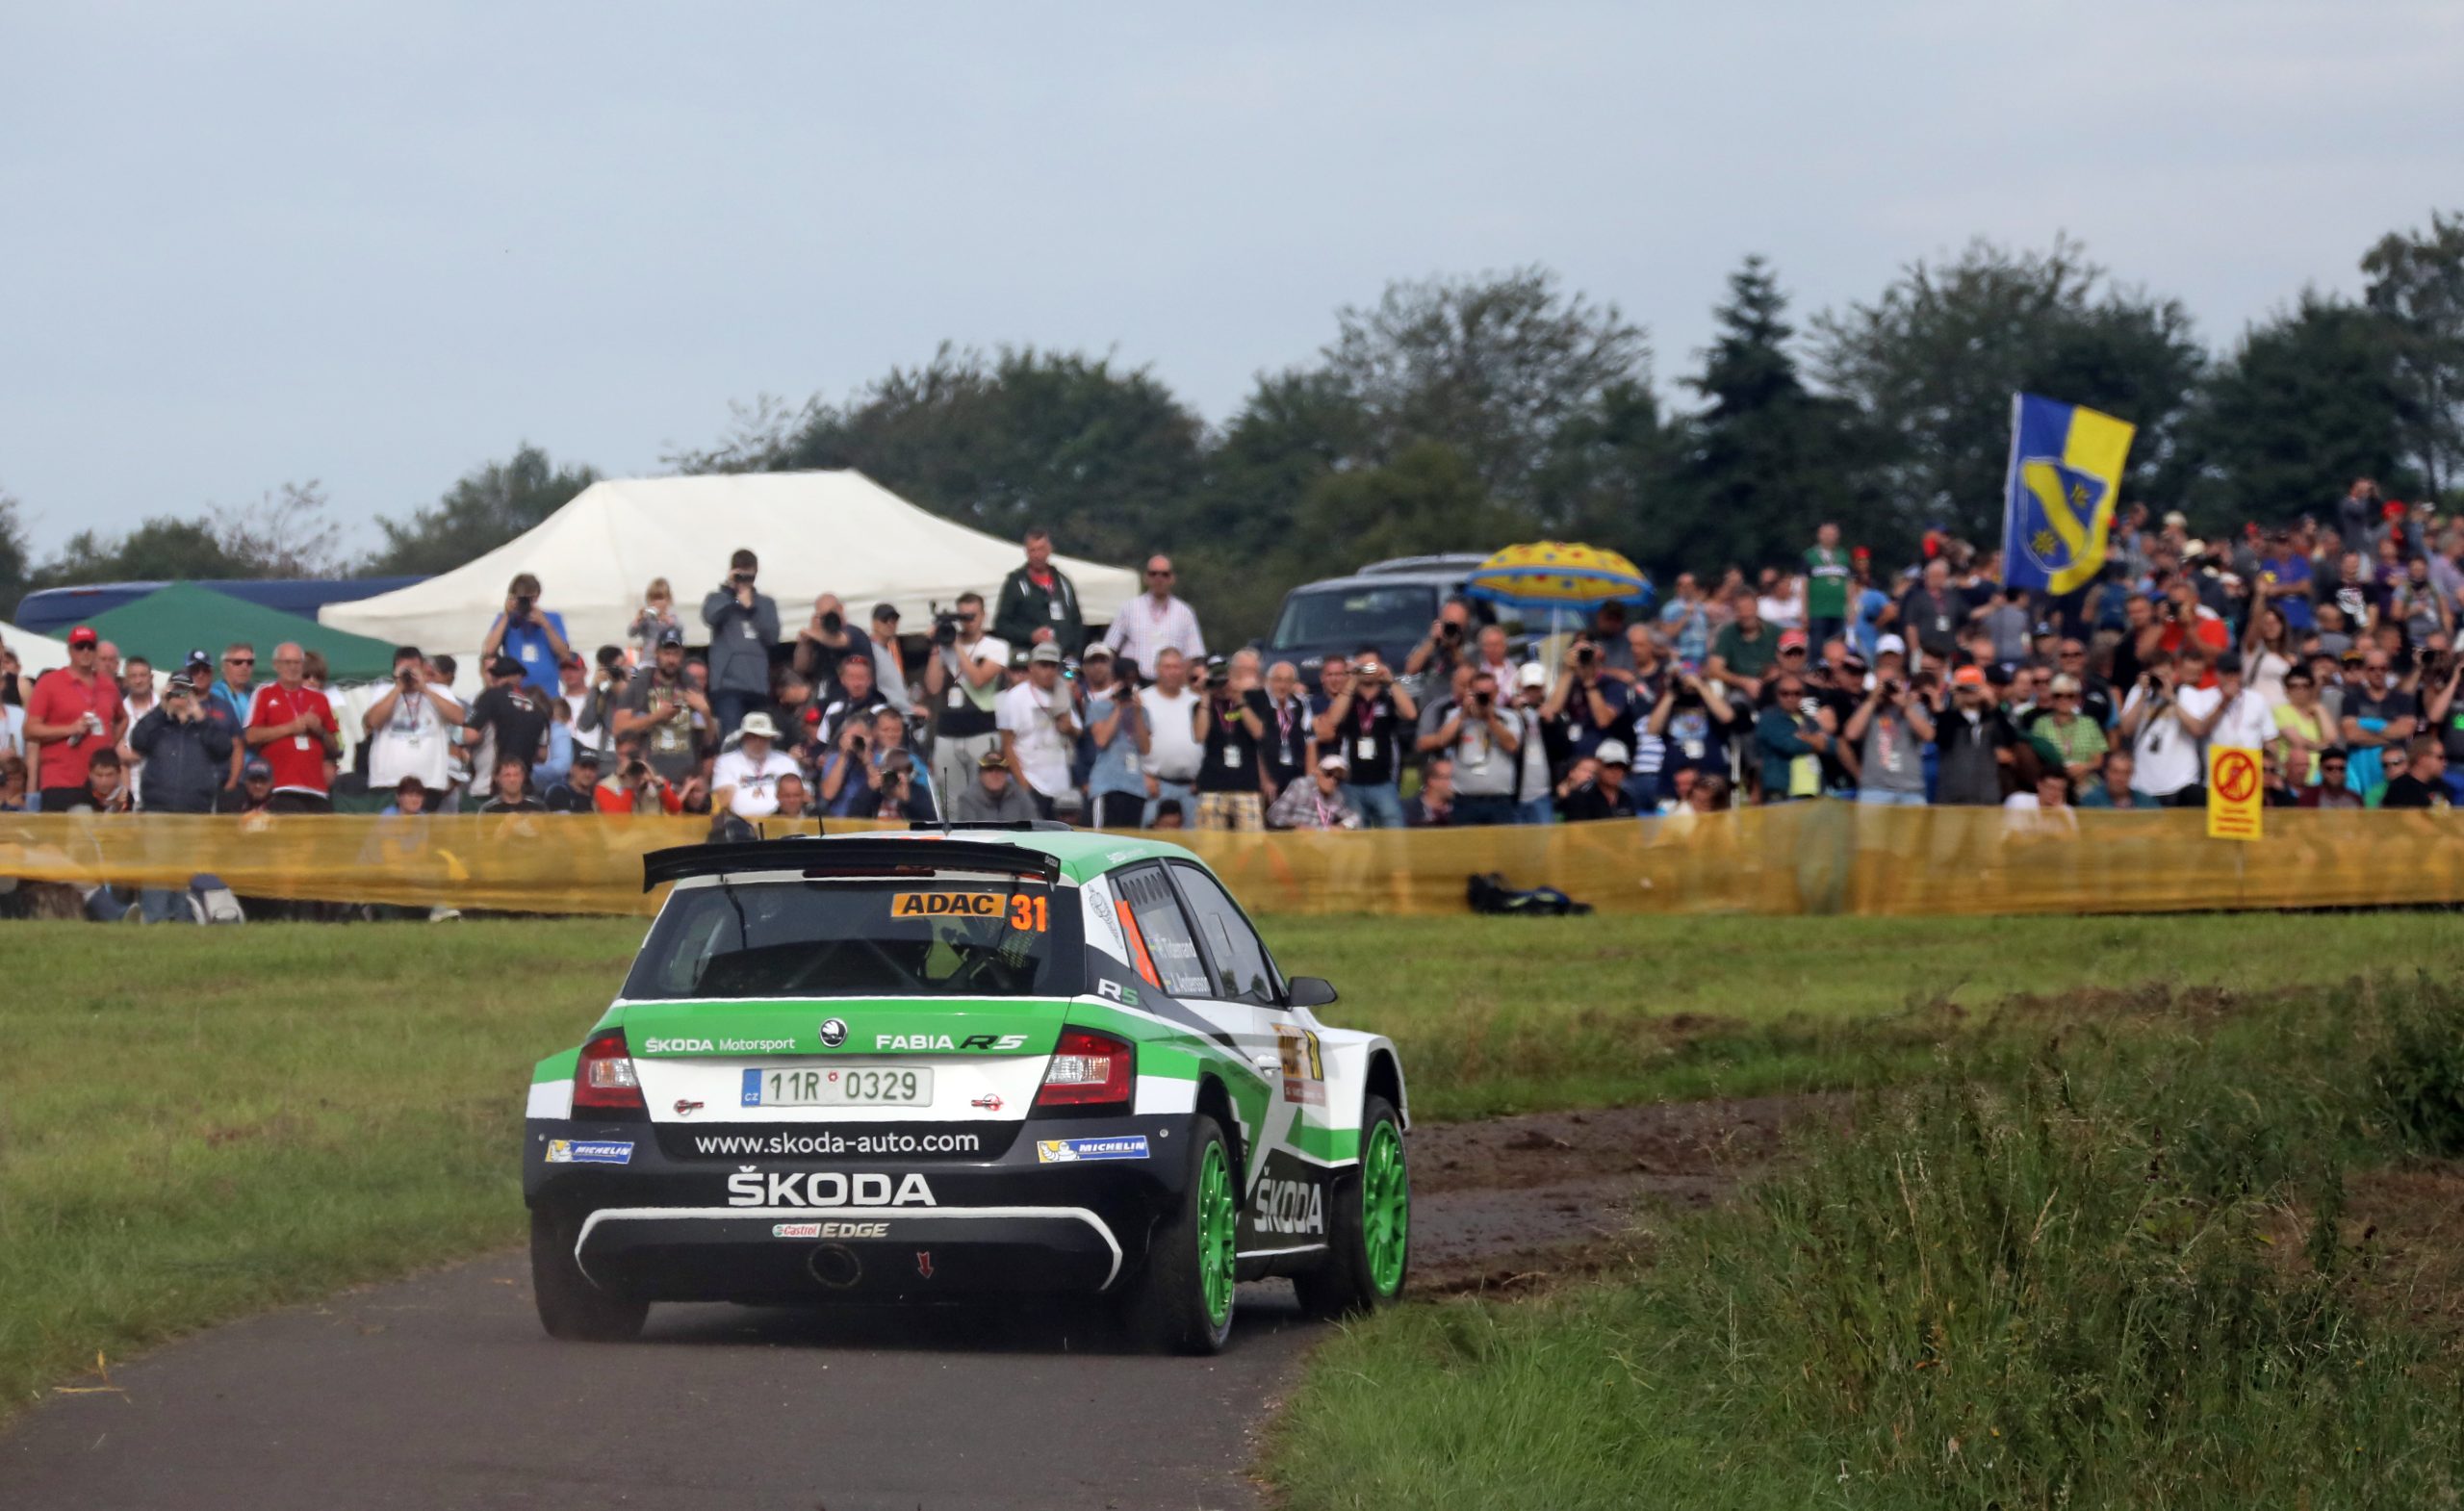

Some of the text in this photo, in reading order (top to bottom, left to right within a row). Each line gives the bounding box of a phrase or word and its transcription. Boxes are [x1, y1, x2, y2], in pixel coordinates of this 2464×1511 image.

[902, 894, 994, 914] ADAC
[1011, 894, 1048, 933] 31
[1097, 977, 1140, 1006] R5
[645, 1037, 796, 1054] ŠKODA Motorsport
[876, 1034, 1029, 1050] FABIA R5
[770, 1071, 918, 1102] 11R 0329
[744, 1092, 759, 1102] CZ
[575, 1145, 631, 1156] MICHELIN
[695, 1131, 980, 1154] www.skoda-auto.com
[1078, 1141, 1145, 1153] MICHELIN
[728, 1165, 937, 1206] ŠKODA
[1253, 1165, 1323, 1235] ŠKODA
[783, 1222, 891, 1239] Castrol EDGE
